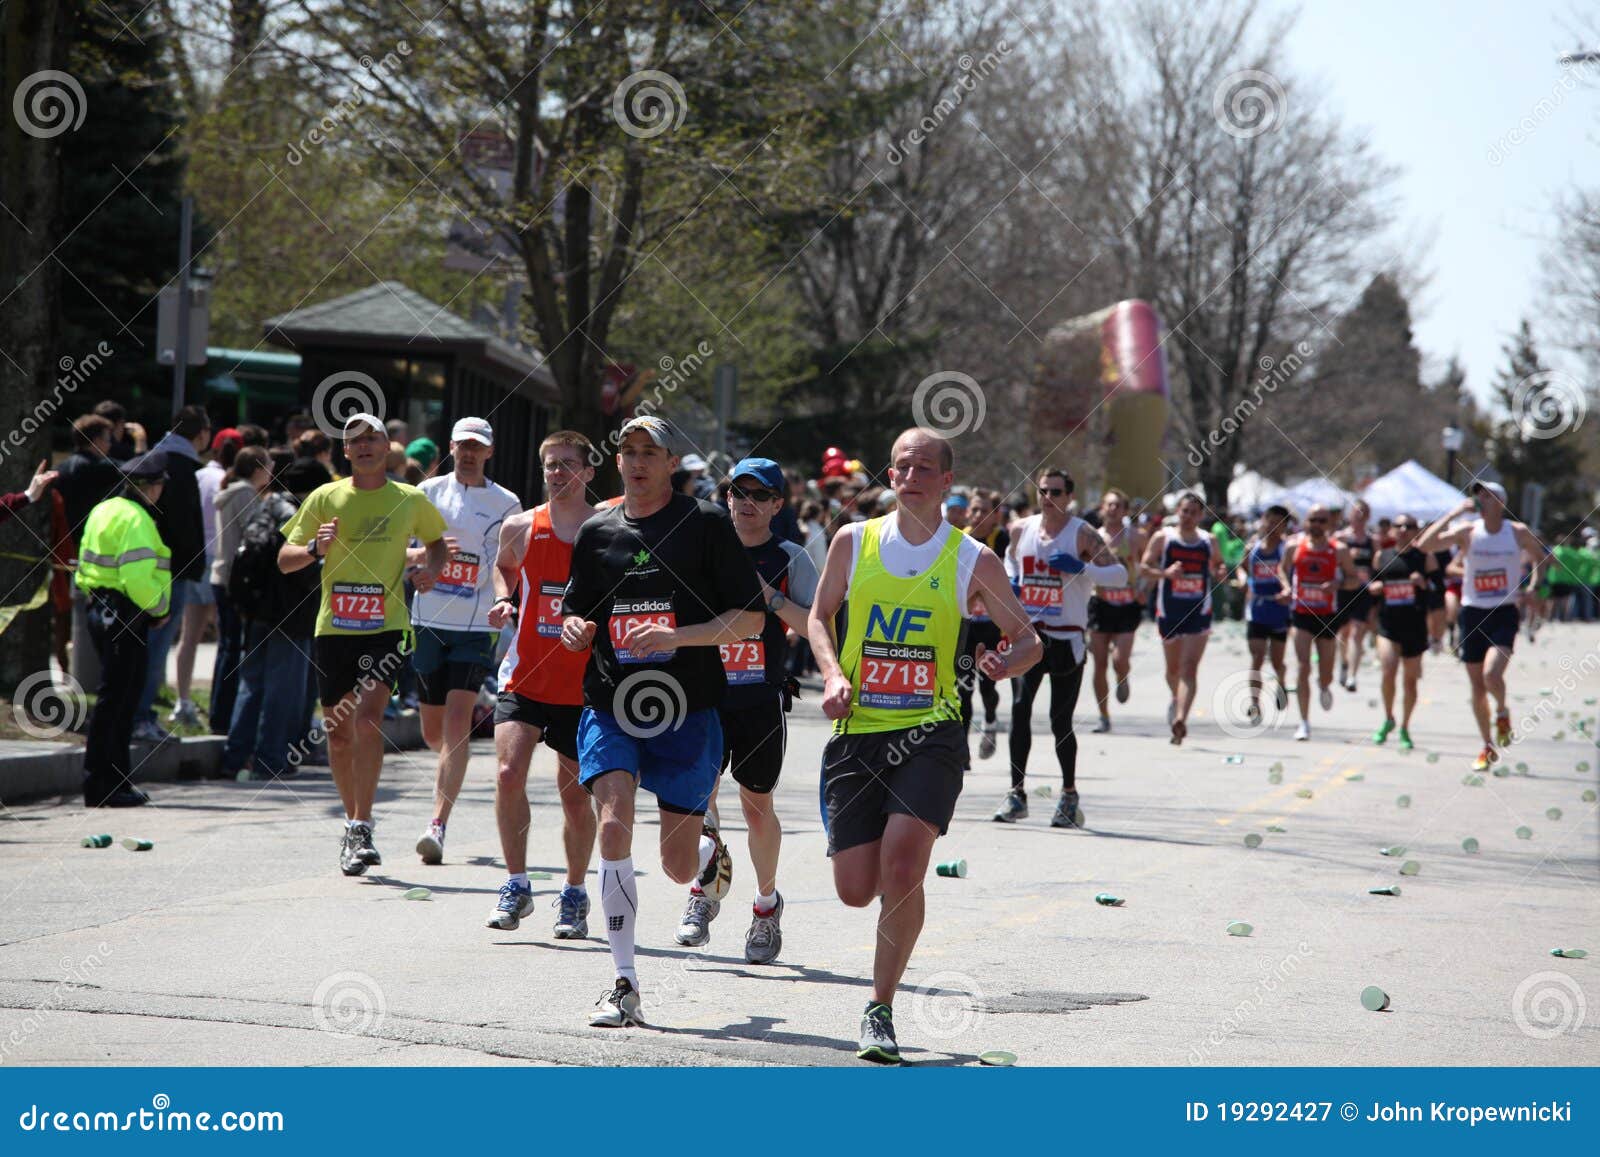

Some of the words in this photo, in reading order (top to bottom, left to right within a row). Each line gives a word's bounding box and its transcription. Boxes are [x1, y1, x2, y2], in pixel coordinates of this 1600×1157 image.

[352, 585, 383, 594] adidas
[1024, 586, 1059, 602] 1778
[336, 595, 381, 613] 1722
[631, 600, 671, 612] adidas
[865, 604, 932, 643] NF
[889, 648, 932, 660] adidas
[865, 661, 929, 687] 2718
